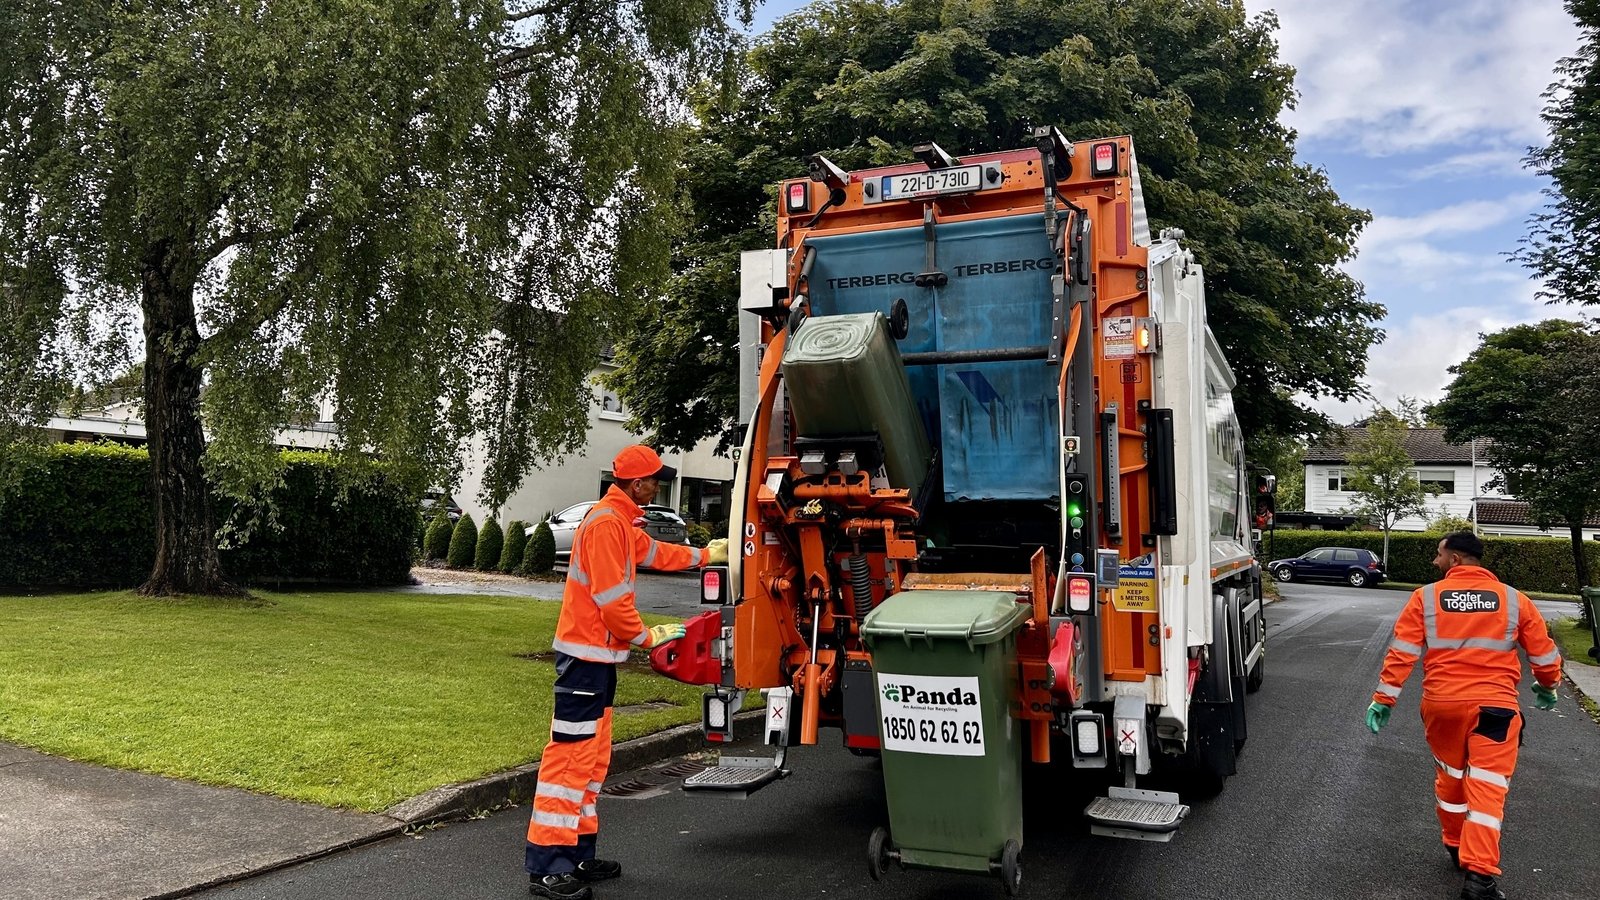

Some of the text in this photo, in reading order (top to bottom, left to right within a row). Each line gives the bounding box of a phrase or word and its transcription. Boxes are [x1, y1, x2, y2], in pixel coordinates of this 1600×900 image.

[901, 171, 969, 193] 221-D-7310
[953, 257, 1054, 277] TERBERG
[826, 271, 915, 290] TERBERG
[1444, 598, 1496, 611] Together
[1451, 591, 1481, 602] Safer
[899, 685, 977, 705] Panda
[884, 716, 981, 744] 1850 62 62 62
